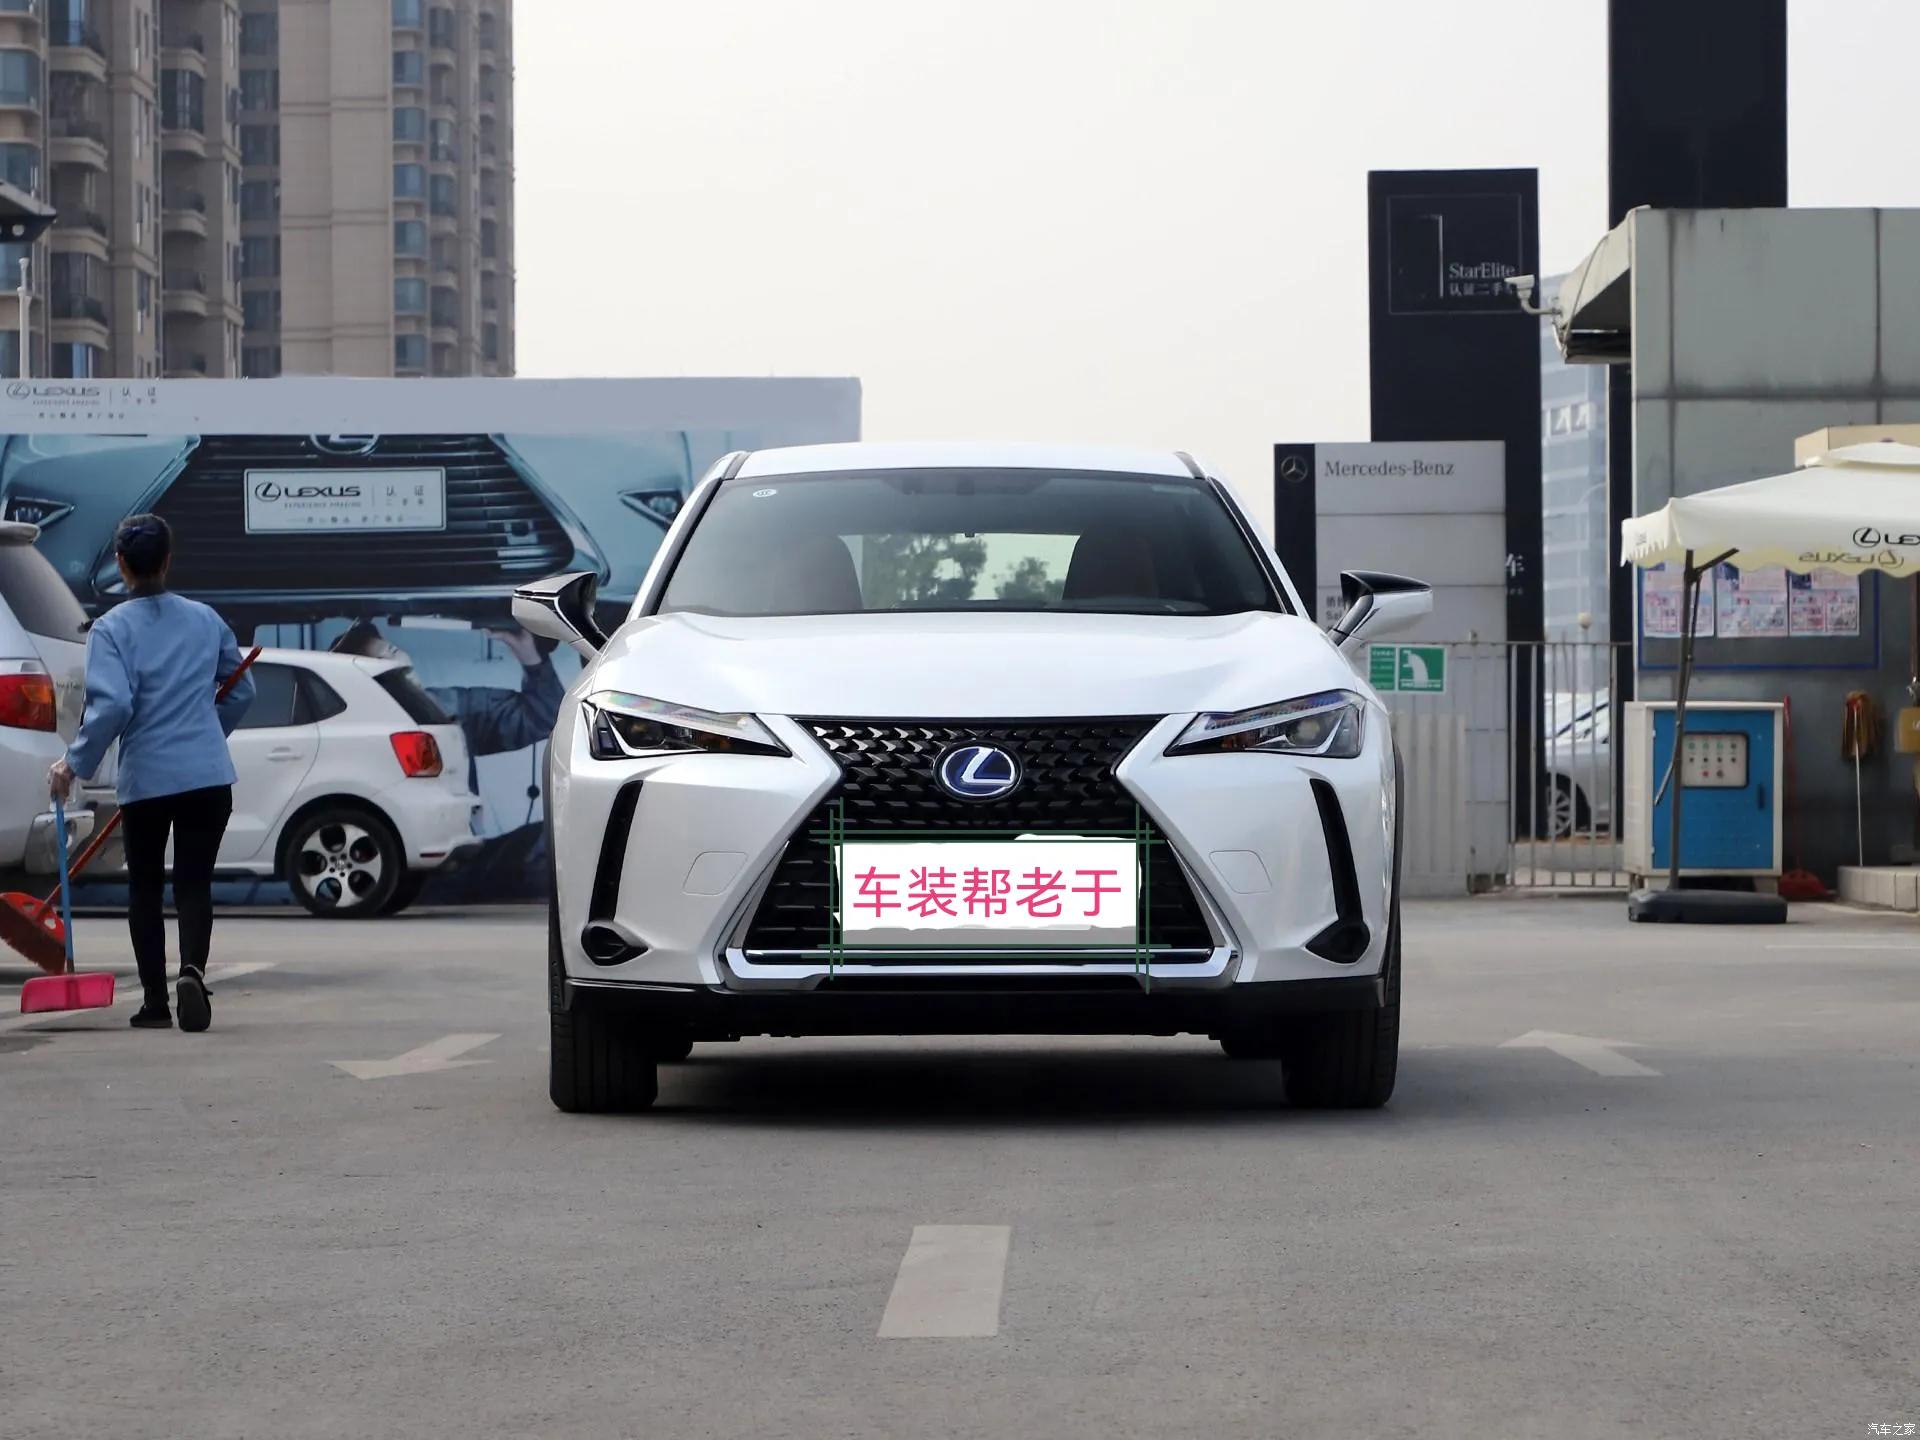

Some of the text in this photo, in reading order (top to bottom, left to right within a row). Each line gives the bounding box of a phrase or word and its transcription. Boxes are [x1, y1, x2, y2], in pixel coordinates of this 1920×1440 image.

[1449, 262, 1516, 279] StarElite
[33, 385, 100, 396] LEXUS
[1324, 460, 1456, 477] Mercedes-Benz
[284, 485, 361, 498] LEXUS
[1884, 533, 1920, 546] LE
